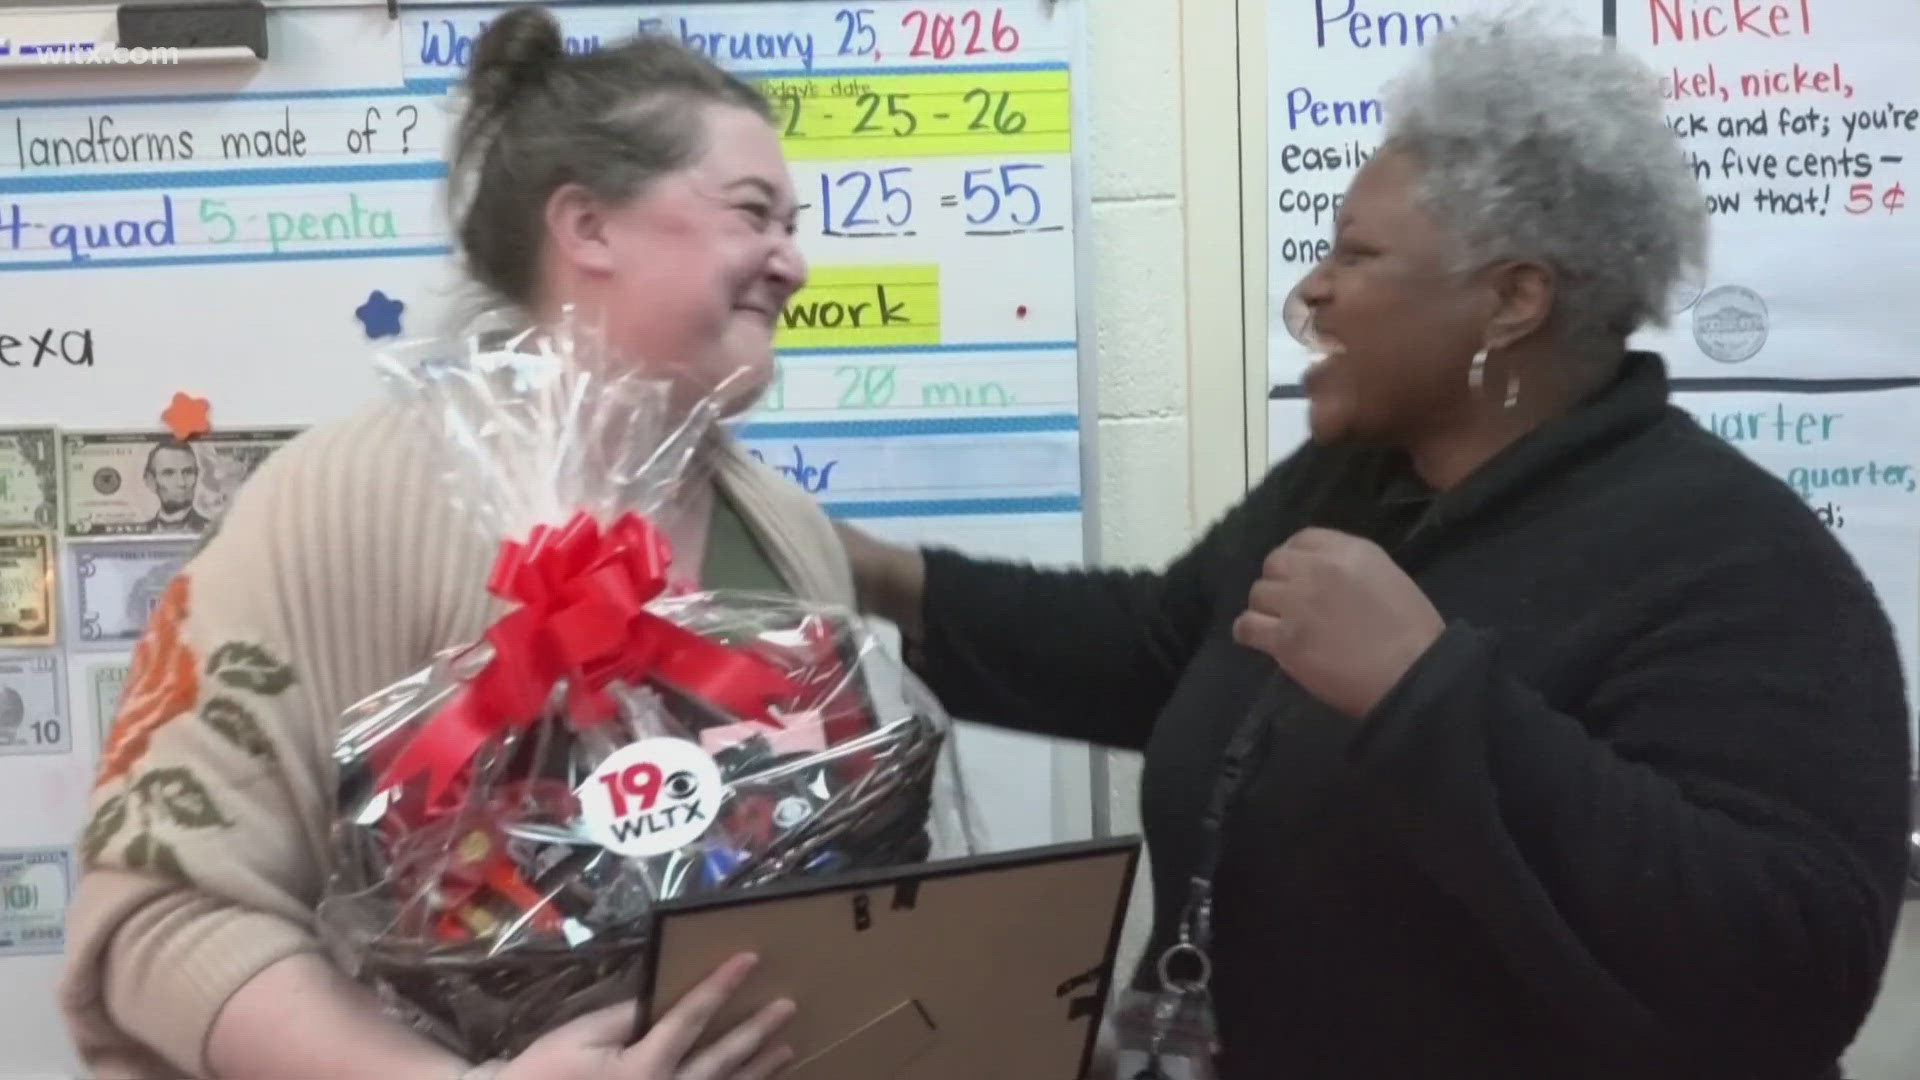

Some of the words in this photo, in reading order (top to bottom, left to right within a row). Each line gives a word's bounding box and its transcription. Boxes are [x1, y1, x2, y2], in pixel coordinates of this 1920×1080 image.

[639, 16, 813, 72] bruary
[902, 10, 1020, 59] 2026
[1314, 0, 1460, 49] Penn
[1649, 0, 1812, 46] Nickel
[831, 78, 871, 97] date
[1740, 62, 1854, 99] nickel,
[852, 92, 917, 137] 25
[963, 88, 1027, 135] 26
[1717, 108, 1769, 138] and
[1777, 107, 1831, 138] fat;
[1841, 103, 1920, 143] you're
[17, 115, 194, 170] landforms
[221, 106, 307, 159] made
[1721, 146, 1778, 180] five
[1785, 147, 1874, 180] cents
[1753, 183, 1832, 217] that!
[782, 284, 911, 329] work
[833, 364, 897, 410] 20
[1787, 460, 1917, 500] quarter,
[31, 718, 61, 745] 10
[598, 761, 663, 819] 19
[609, 799, 706, 844] WLTX
